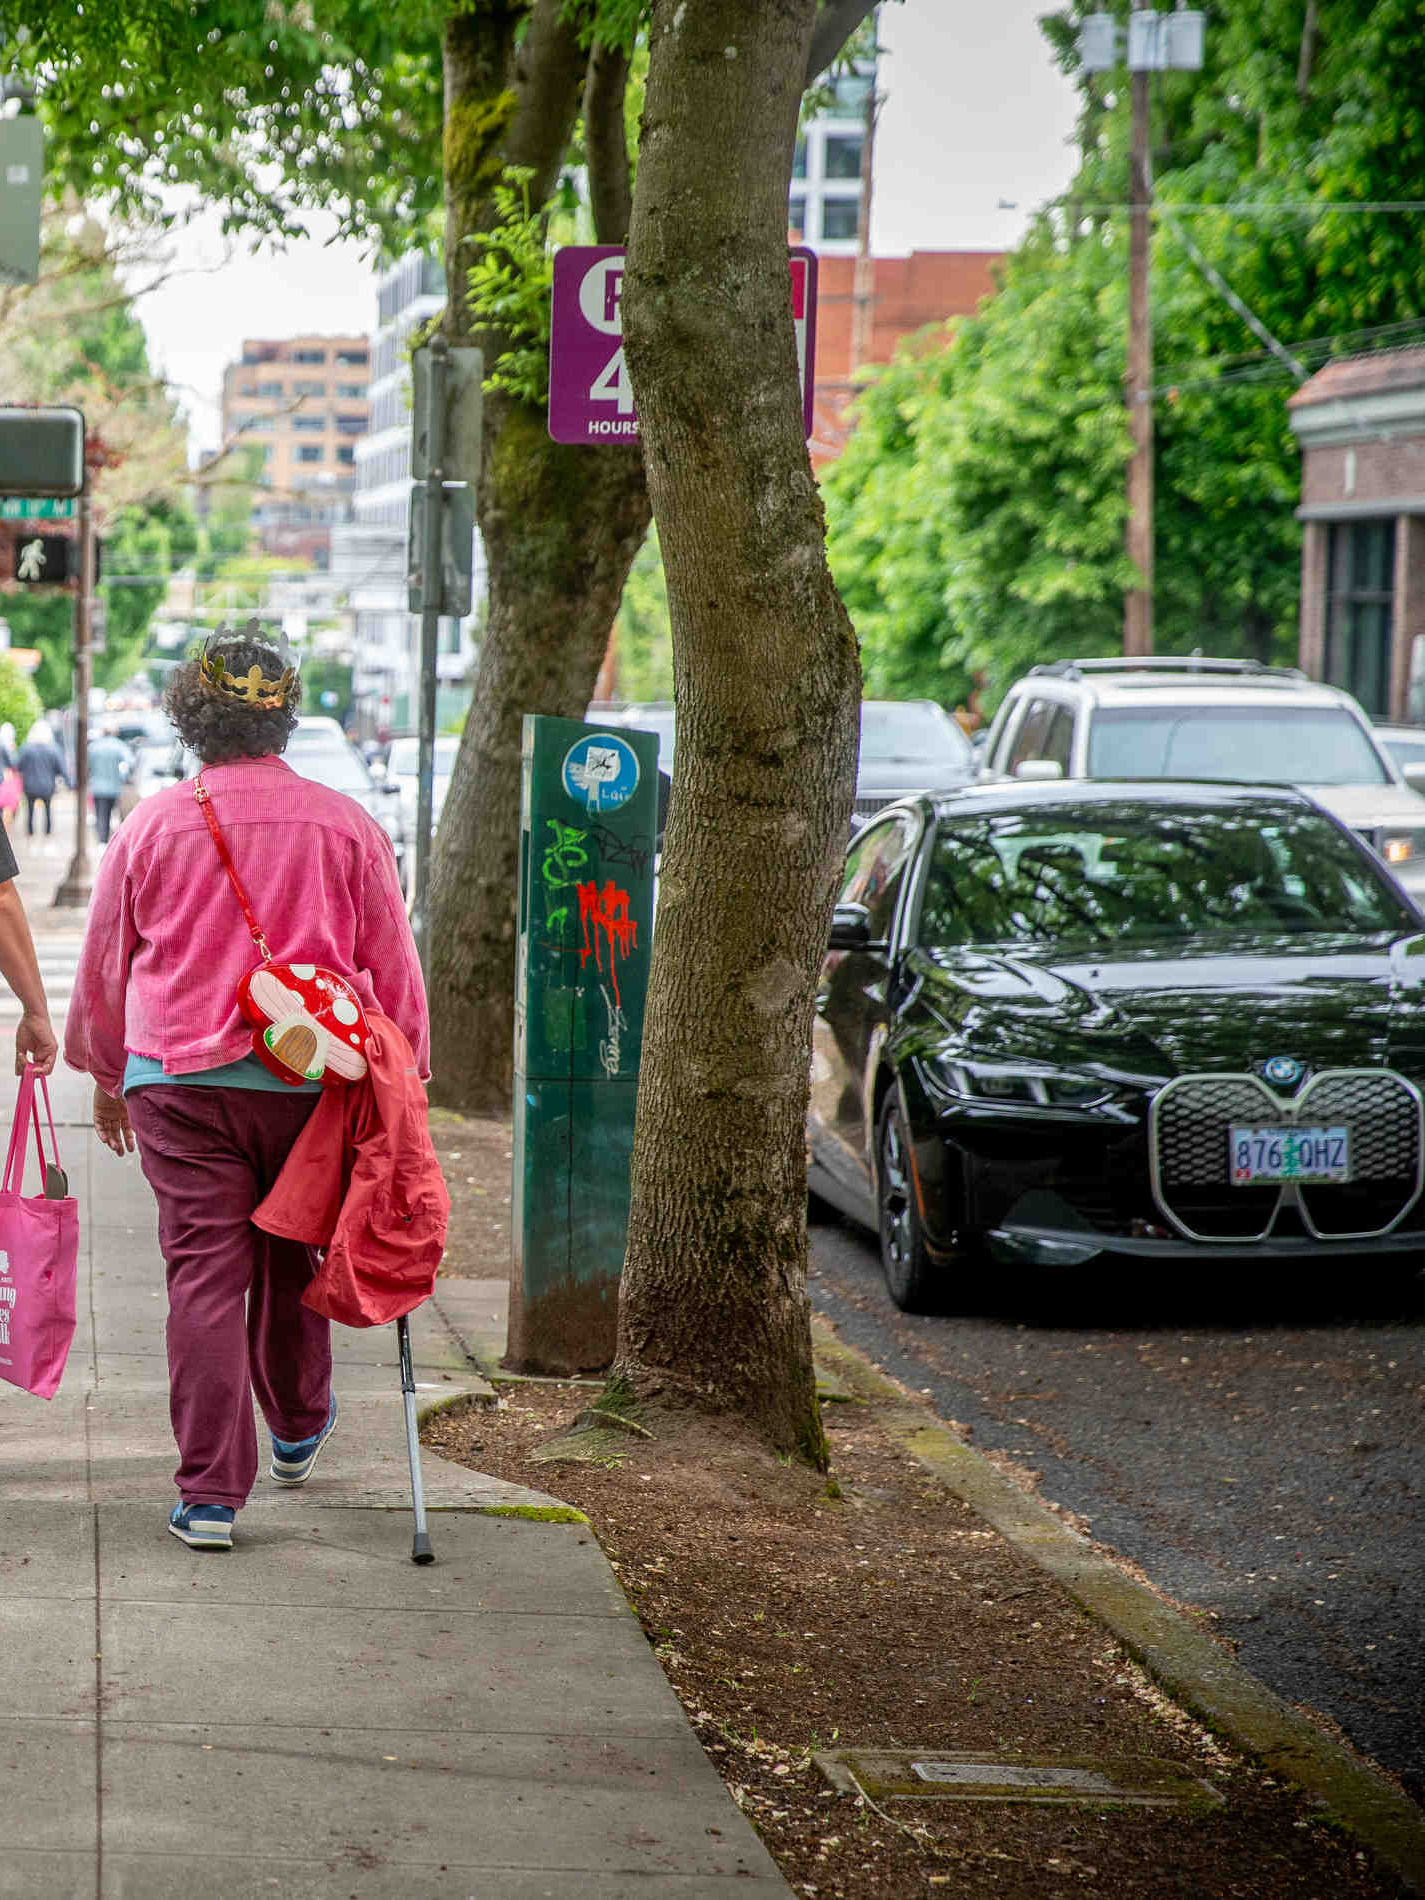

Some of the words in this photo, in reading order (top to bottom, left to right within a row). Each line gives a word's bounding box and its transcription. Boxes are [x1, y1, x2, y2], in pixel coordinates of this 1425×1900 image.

[589, 345, 635, 415] 4
[588, 420, 640, 435] HOURS
[1237, 1139, 1281, 1169] 876
